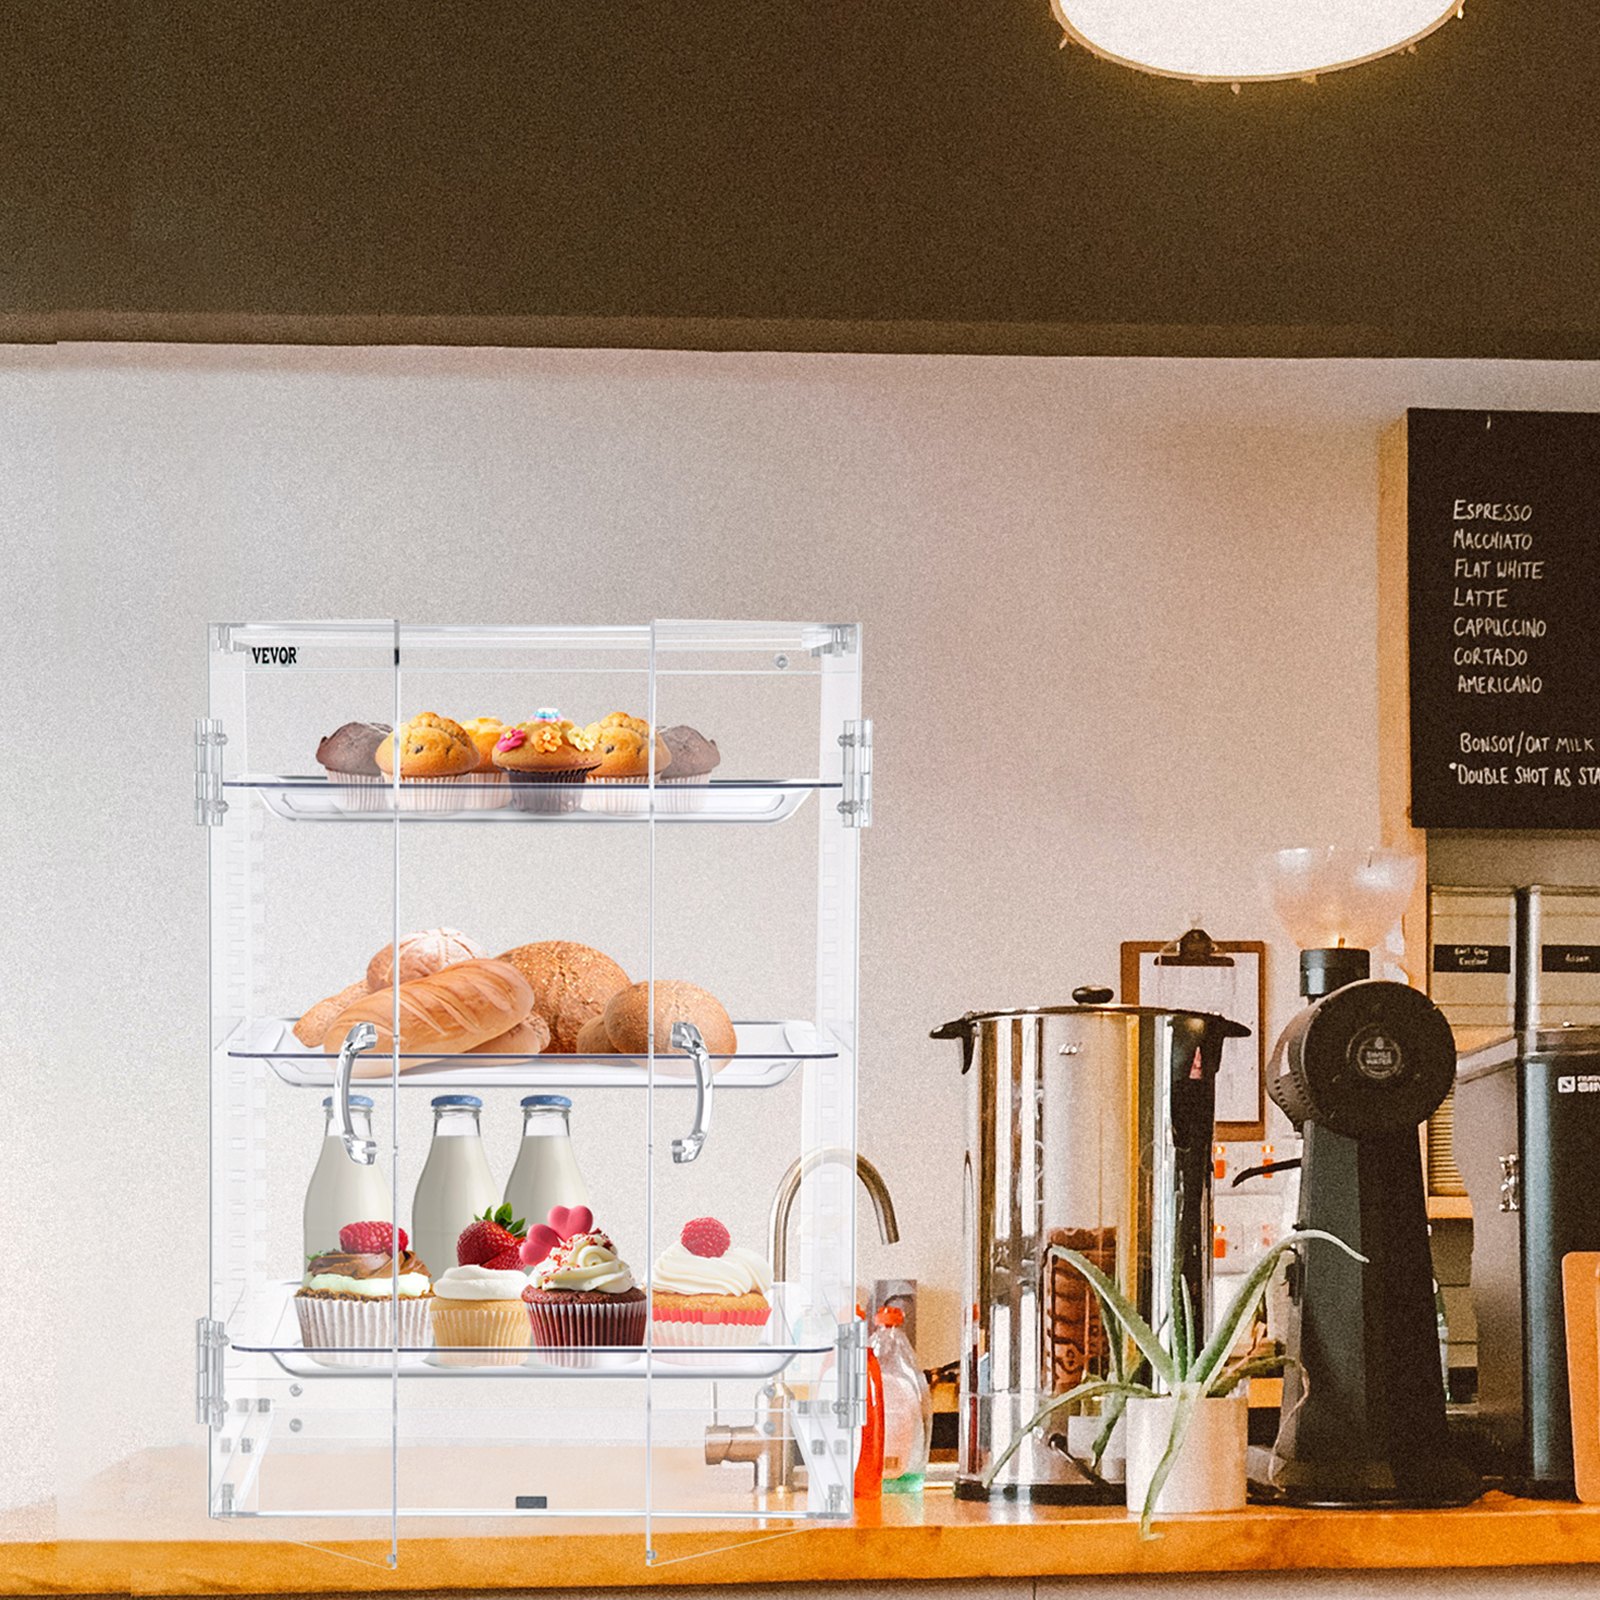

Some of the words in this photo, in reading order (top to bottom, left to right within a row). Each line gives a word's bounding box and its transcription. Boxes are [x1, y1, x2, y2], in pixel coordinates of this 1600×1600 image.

[1453, 499, 1532, 522] ESPRESSO
[1453, 528, 1533, 550] MACCHIATO
[1454, 558, 1491, 578] FLAT
[1497, 560, 1544, 580] WHITE
[1453, 587, 1508, 607] LATTE
[1453, 617, 1547, 637] CAPPUCCINO
[252, 646, 297, 664] VEVOR
[1453, 647, 1528, 667] CORTADO
[1457, 675, 1542, 694] AMERICANO
[1555, 738, 1595, 753] MILK
[1514, 766, 1549, 786] SHOT
[1554, 768, 1571, 787] AS
